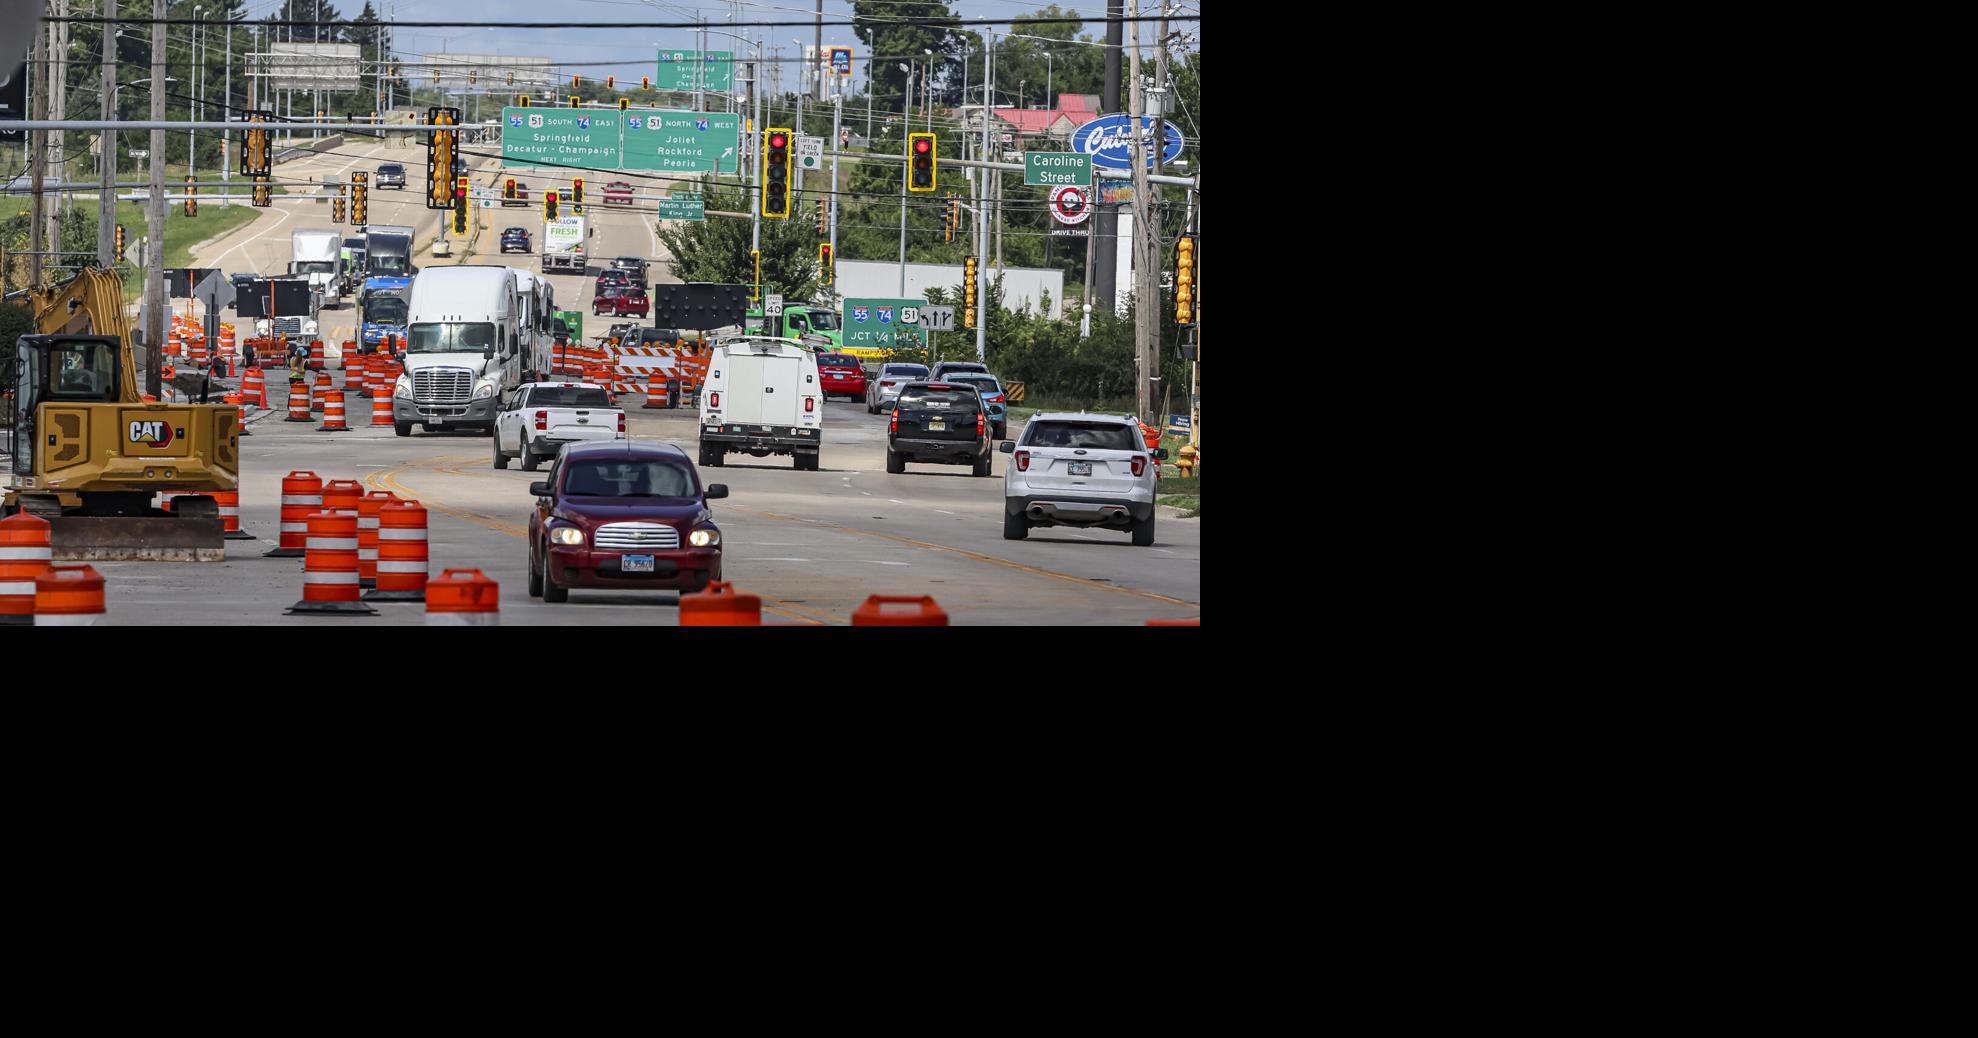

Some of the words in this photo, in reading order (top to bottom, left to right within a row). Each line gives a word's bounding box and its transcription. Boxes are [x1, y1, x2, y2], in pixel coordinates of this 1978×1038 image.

[510, 117, 523, 126] 55
[531, 116, 542, 125] 51
[629, 118, 642, 127] 55
[650, 118, 660, 126] 51
[697, 121, 708, 129] 74
[533, 133, 590, 144] Springfield
[665, 135, 695, 144] Joliet
[507, 144, 547, 152] Decatur
[558, 146, 616, 156] Champaign
[657, 147, 702, 156] Rockford
[663, 159, 696, 167] Peoria
[1033, 155, 1084, 167] Caroline
[1040, 171, 1076, 183] Street
[766, 306, 781, 314] 40
[854, 310, 868, 320] 55
[879, 310, 892, 320] 74
[904, 310, 916, 320] 51
[851, 331, 871, 340] JCT
[129, 421, 163, 442] CAT
